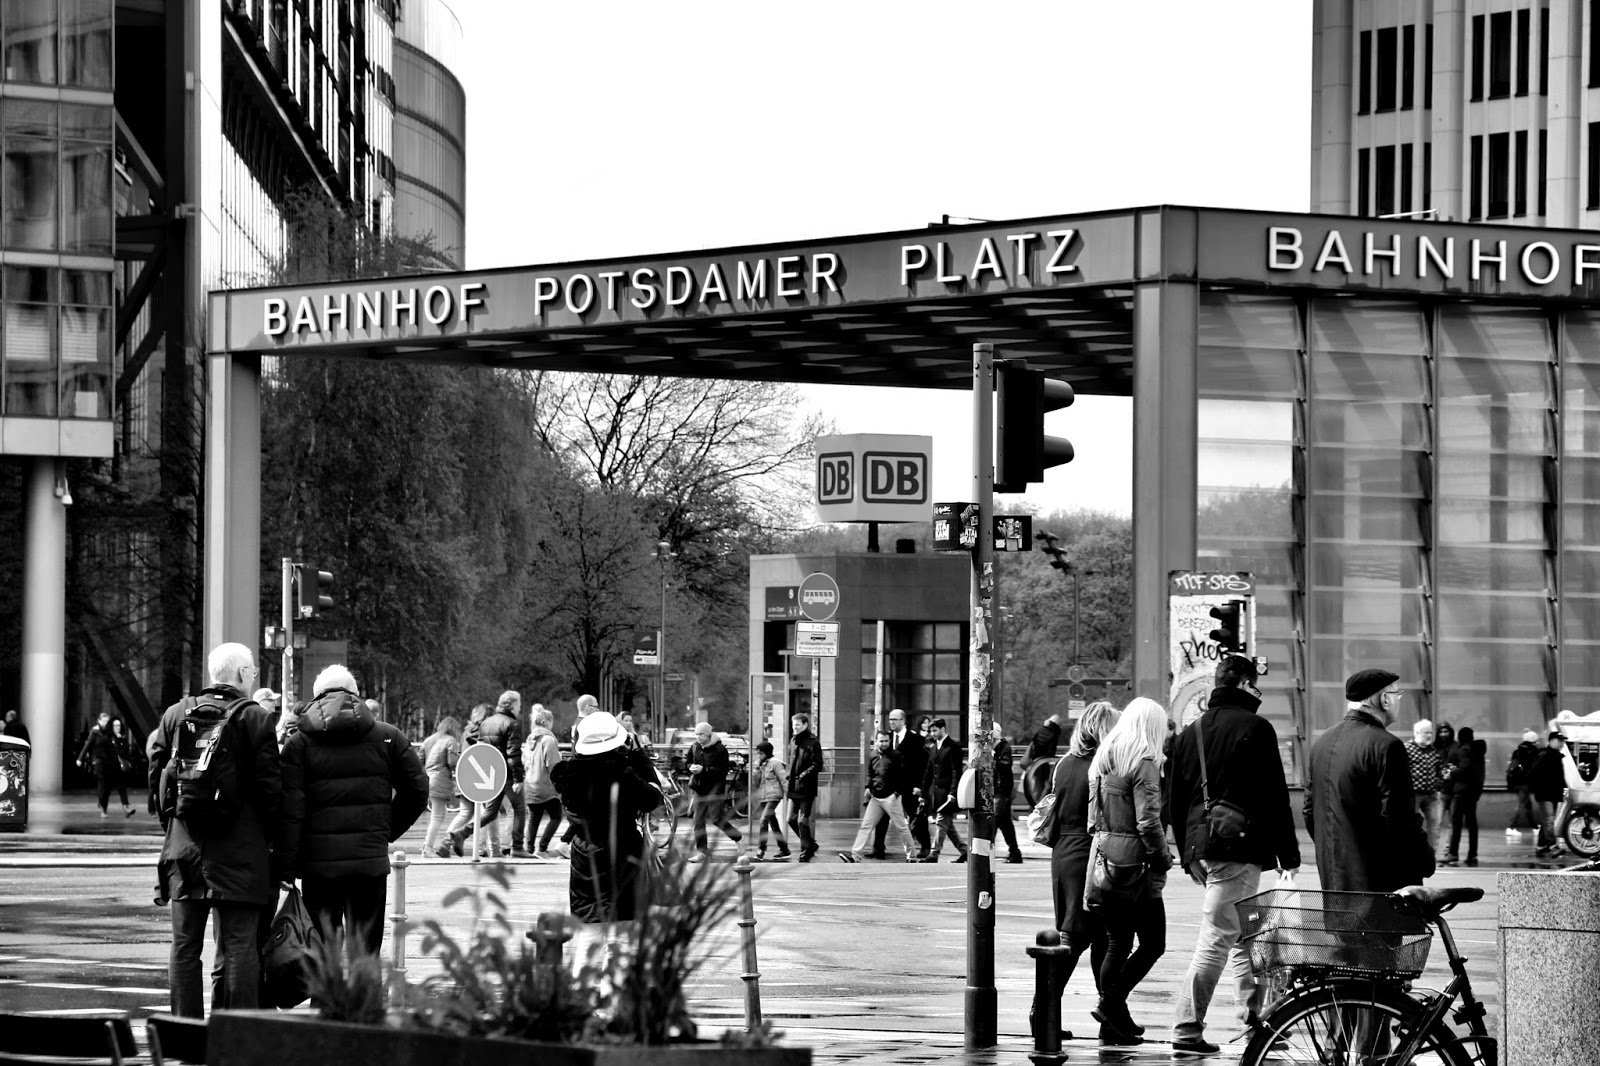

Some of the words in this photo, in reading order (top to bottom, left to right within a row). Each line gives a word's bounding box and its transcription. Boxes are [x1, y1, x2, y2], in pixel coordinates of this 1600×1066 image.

[1267, 226, 1600, 286] BAHNHOF
[263, 282, 484, 336] BAHNHOF
[534, 252, 840, 316] POTSDAMER
[901, 228, 1077, 286] PLATZ
[822, 460, 851, 497] DB
[870, 459, 920, 496] DB
